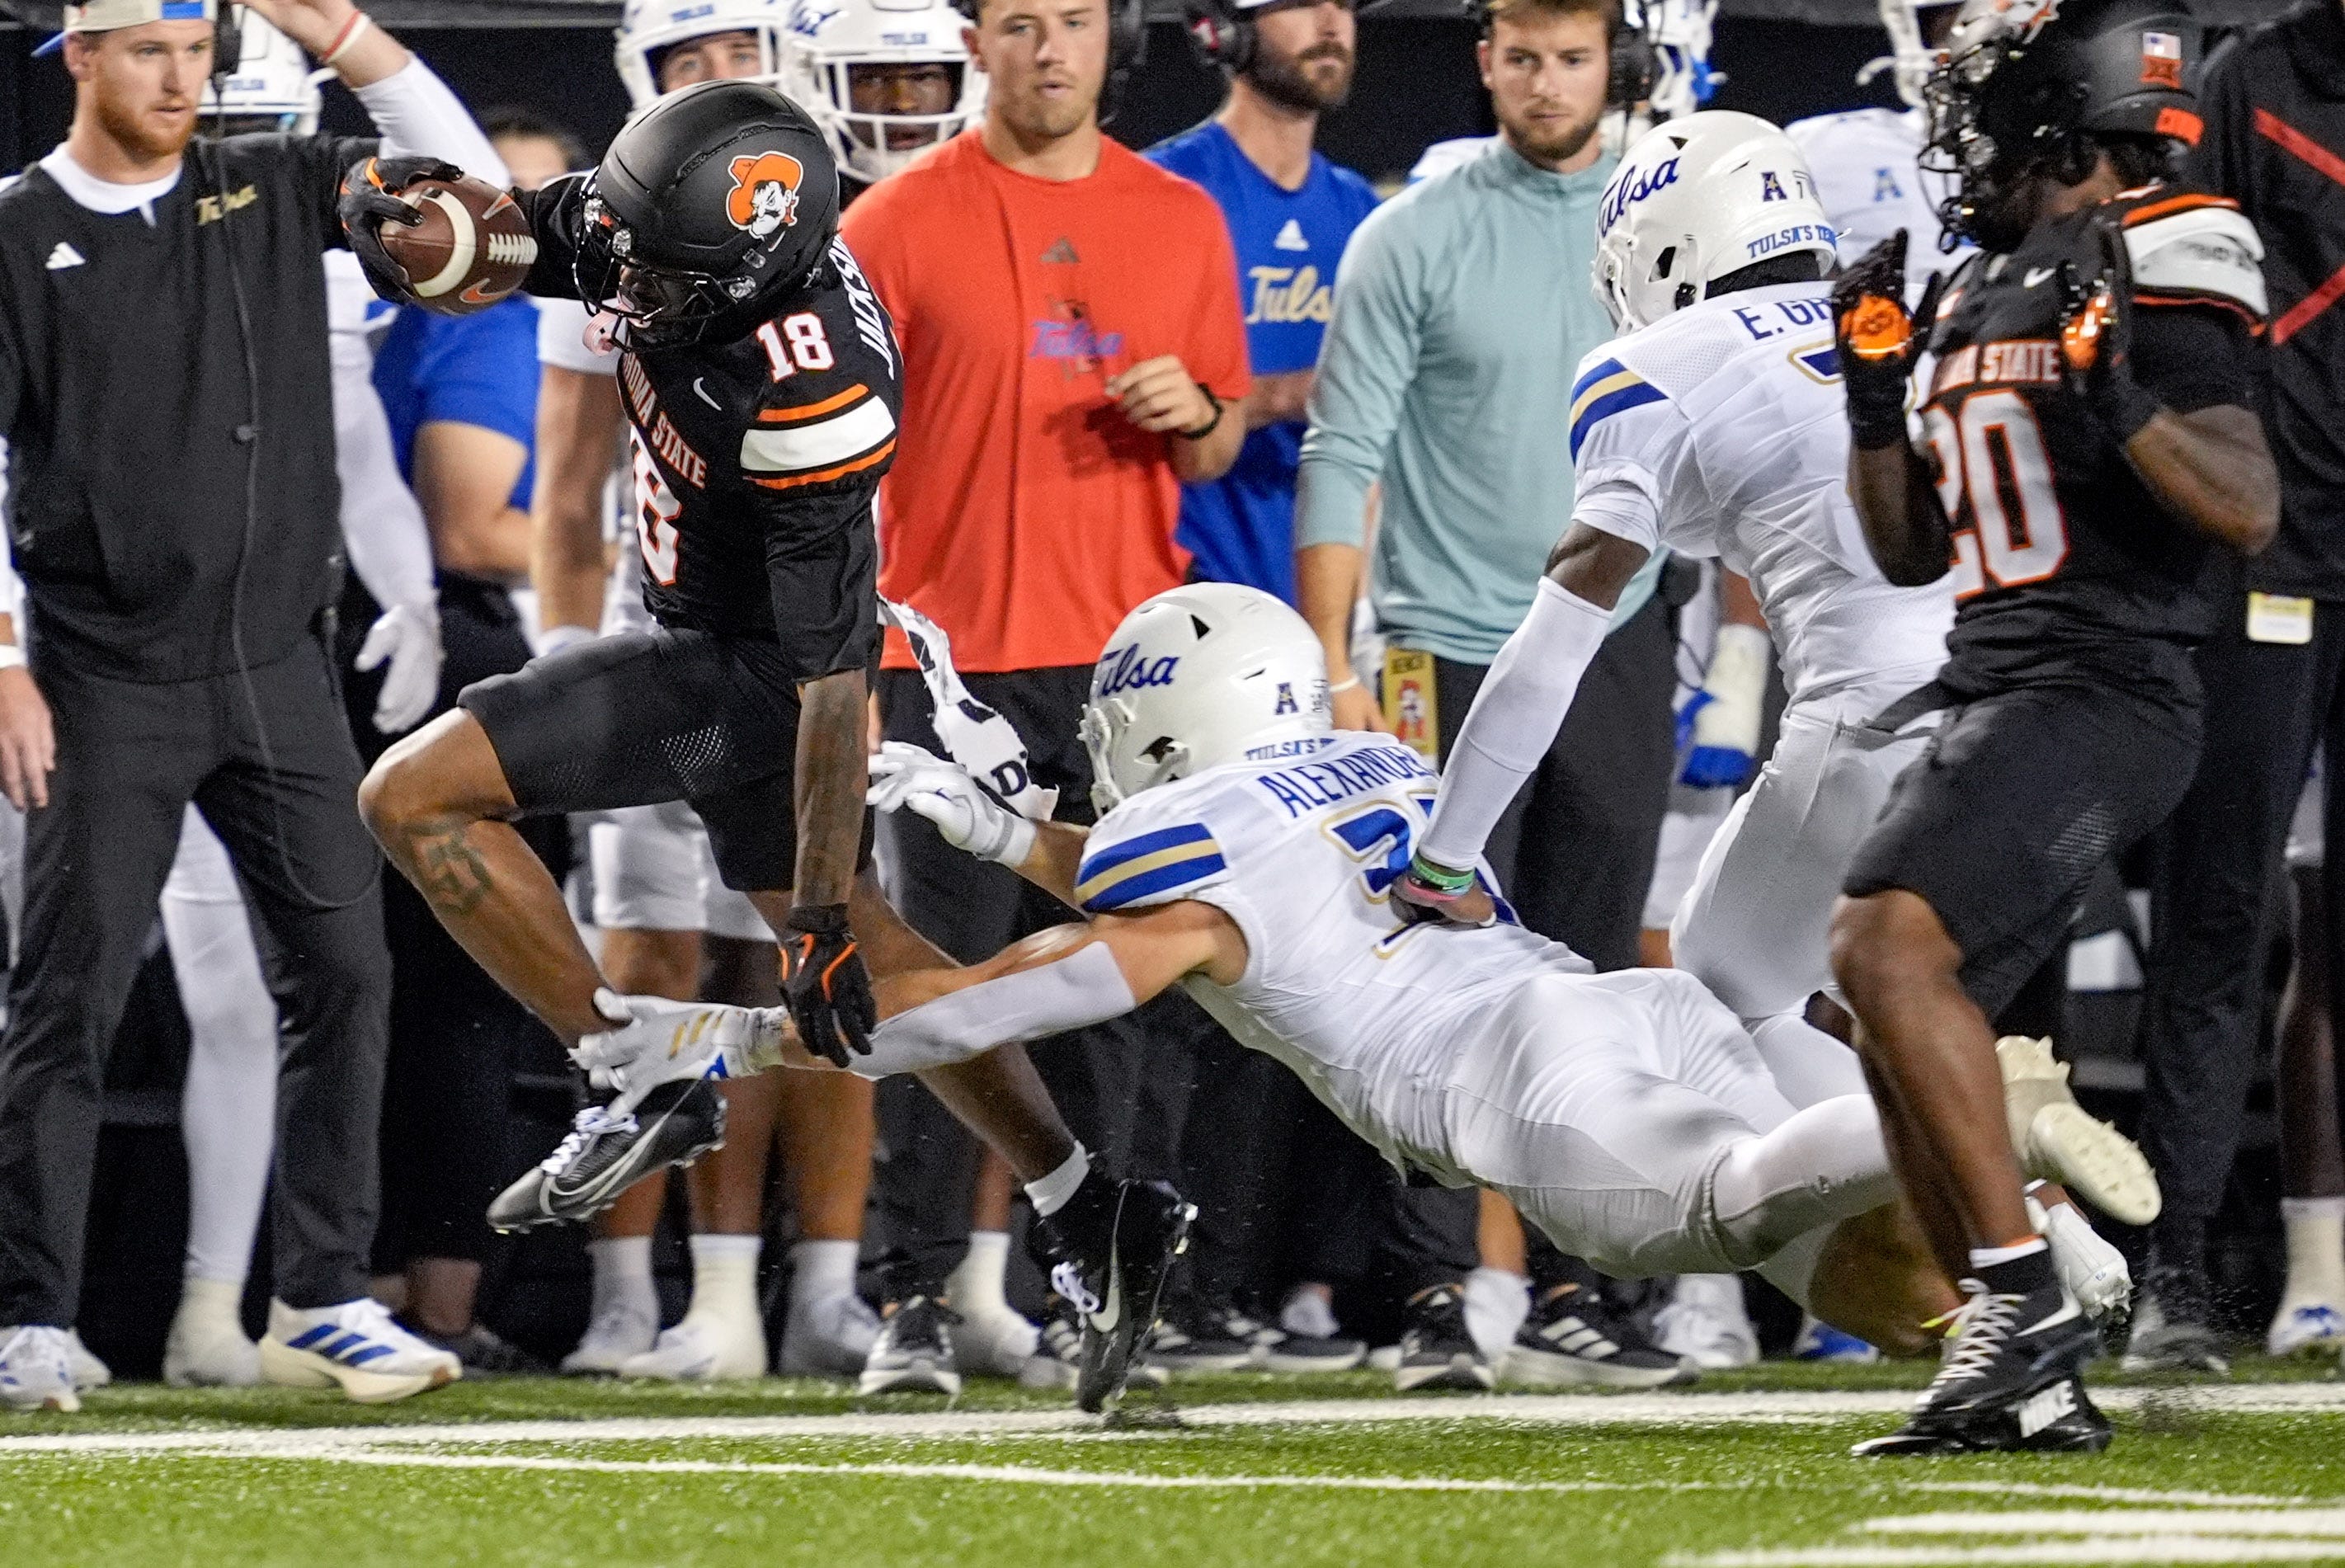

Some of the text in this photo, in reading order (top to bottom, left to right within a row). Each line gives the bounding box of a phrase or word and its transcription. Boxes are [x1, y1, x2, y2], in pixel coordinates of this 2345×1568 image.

[1746, 224, 1813, 259] TULSA'S
[1244, 265, 1333, 324] Tuls
[756, 311, 835, 384] 18
[1980, 339, 2062, 383] STATE
[623, 351, 708, 490] HOMA STATE
